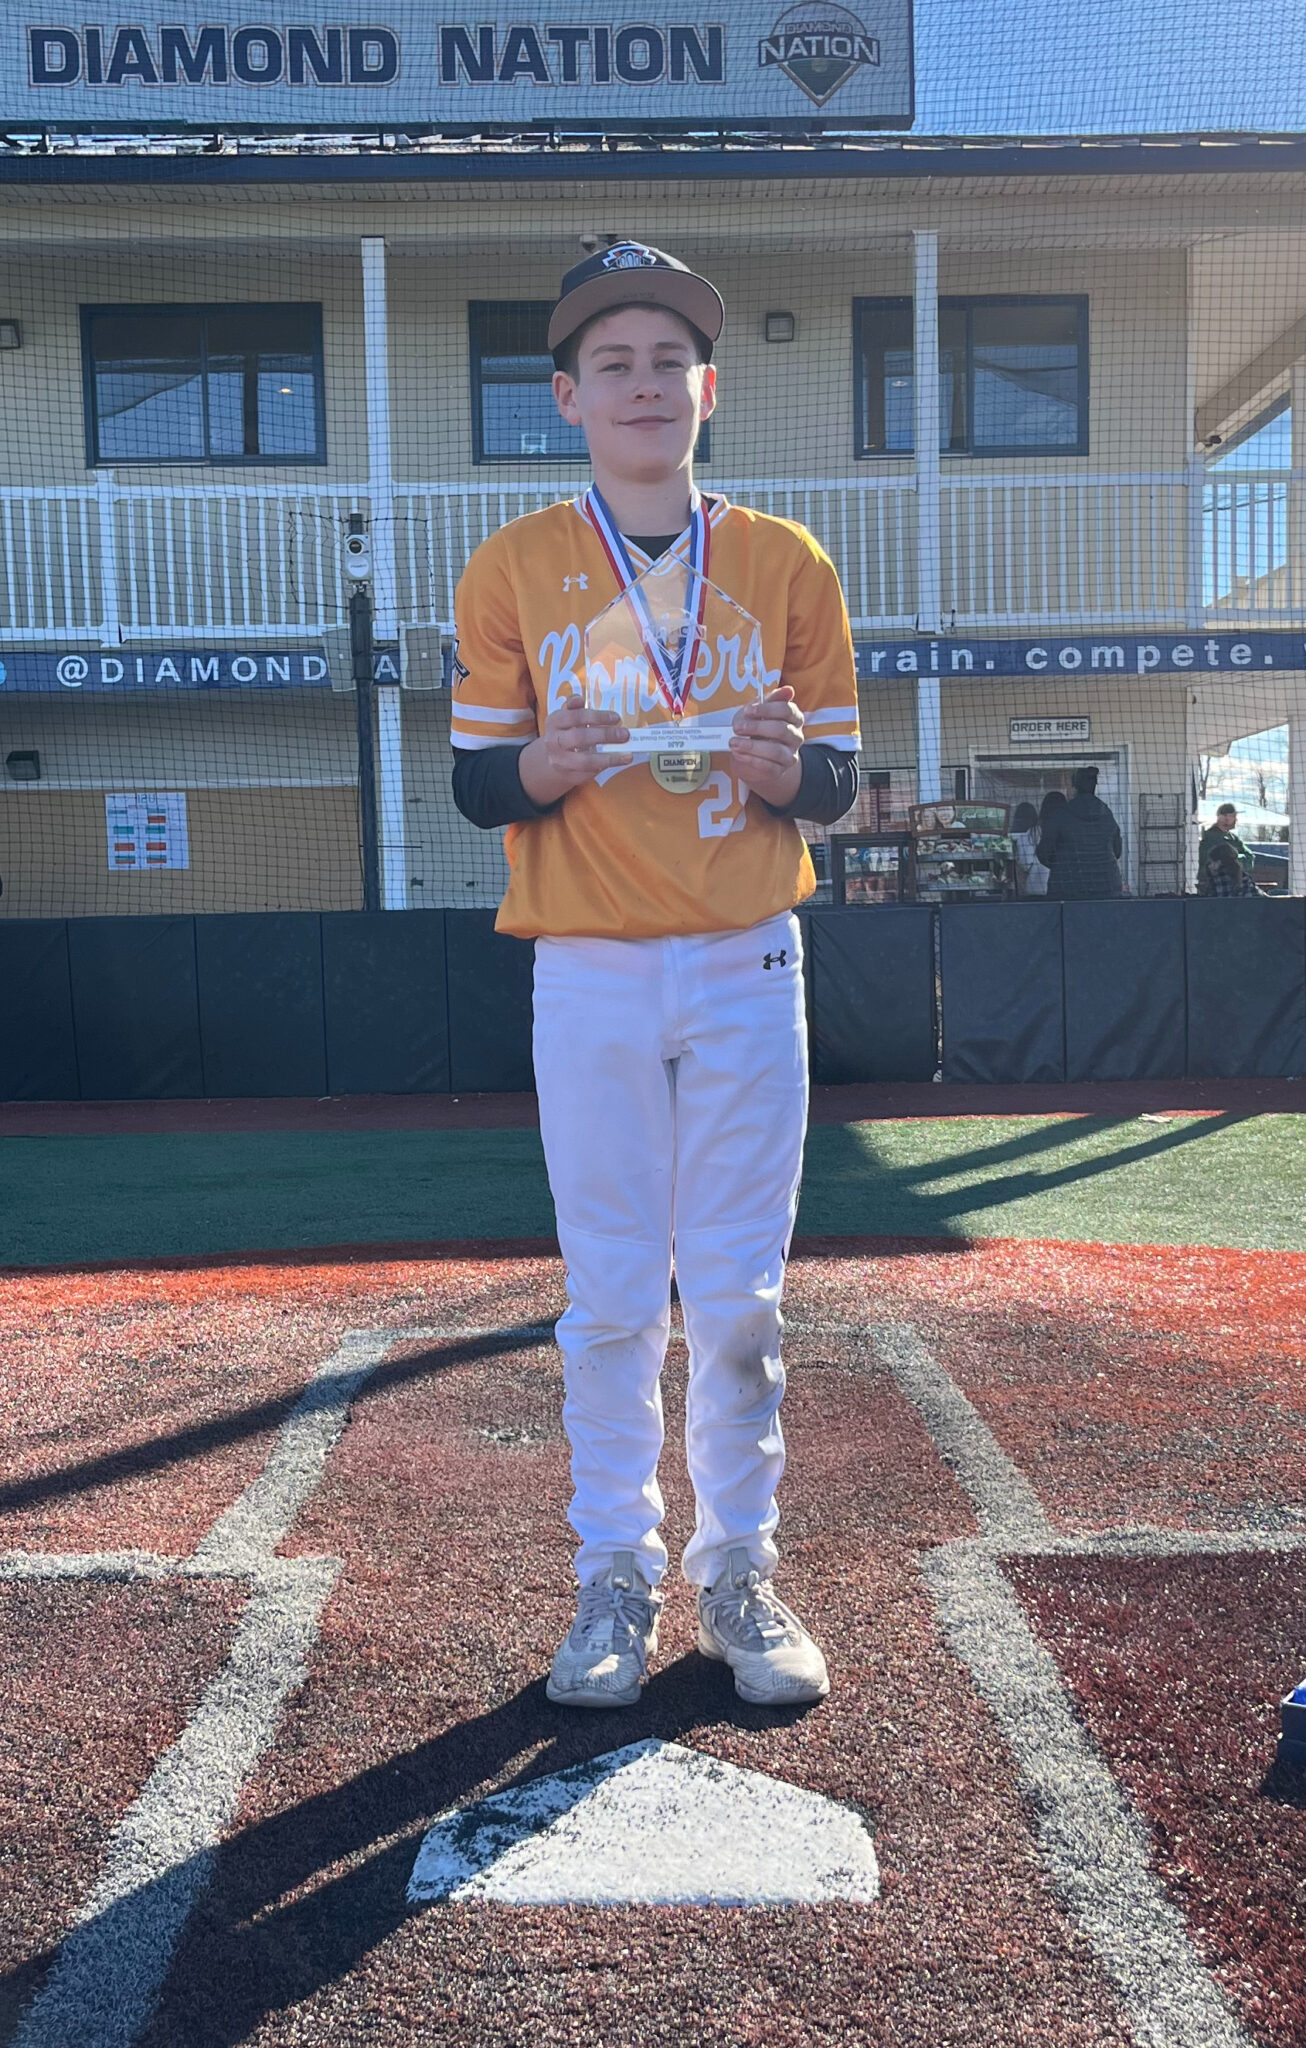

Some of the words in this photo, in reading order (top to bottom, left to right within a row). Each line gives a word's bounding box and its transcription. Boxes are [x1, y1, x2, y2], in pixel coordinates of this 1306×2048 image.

[786, 21, 852, 33] DIAMOND
[28, 26, 399, 86] DIAMOND
[439, 23, 727, 84] NATION
[761, 36, 878, 65] NATION
[854, 642, 995, 673] rain.
[1025, 639, 1273, 674] compete.
[1012, 722, 1052, 732] ORDER
[1056, 721, 1087, 731] HERE
[138, 793, 156, 804] 12U
